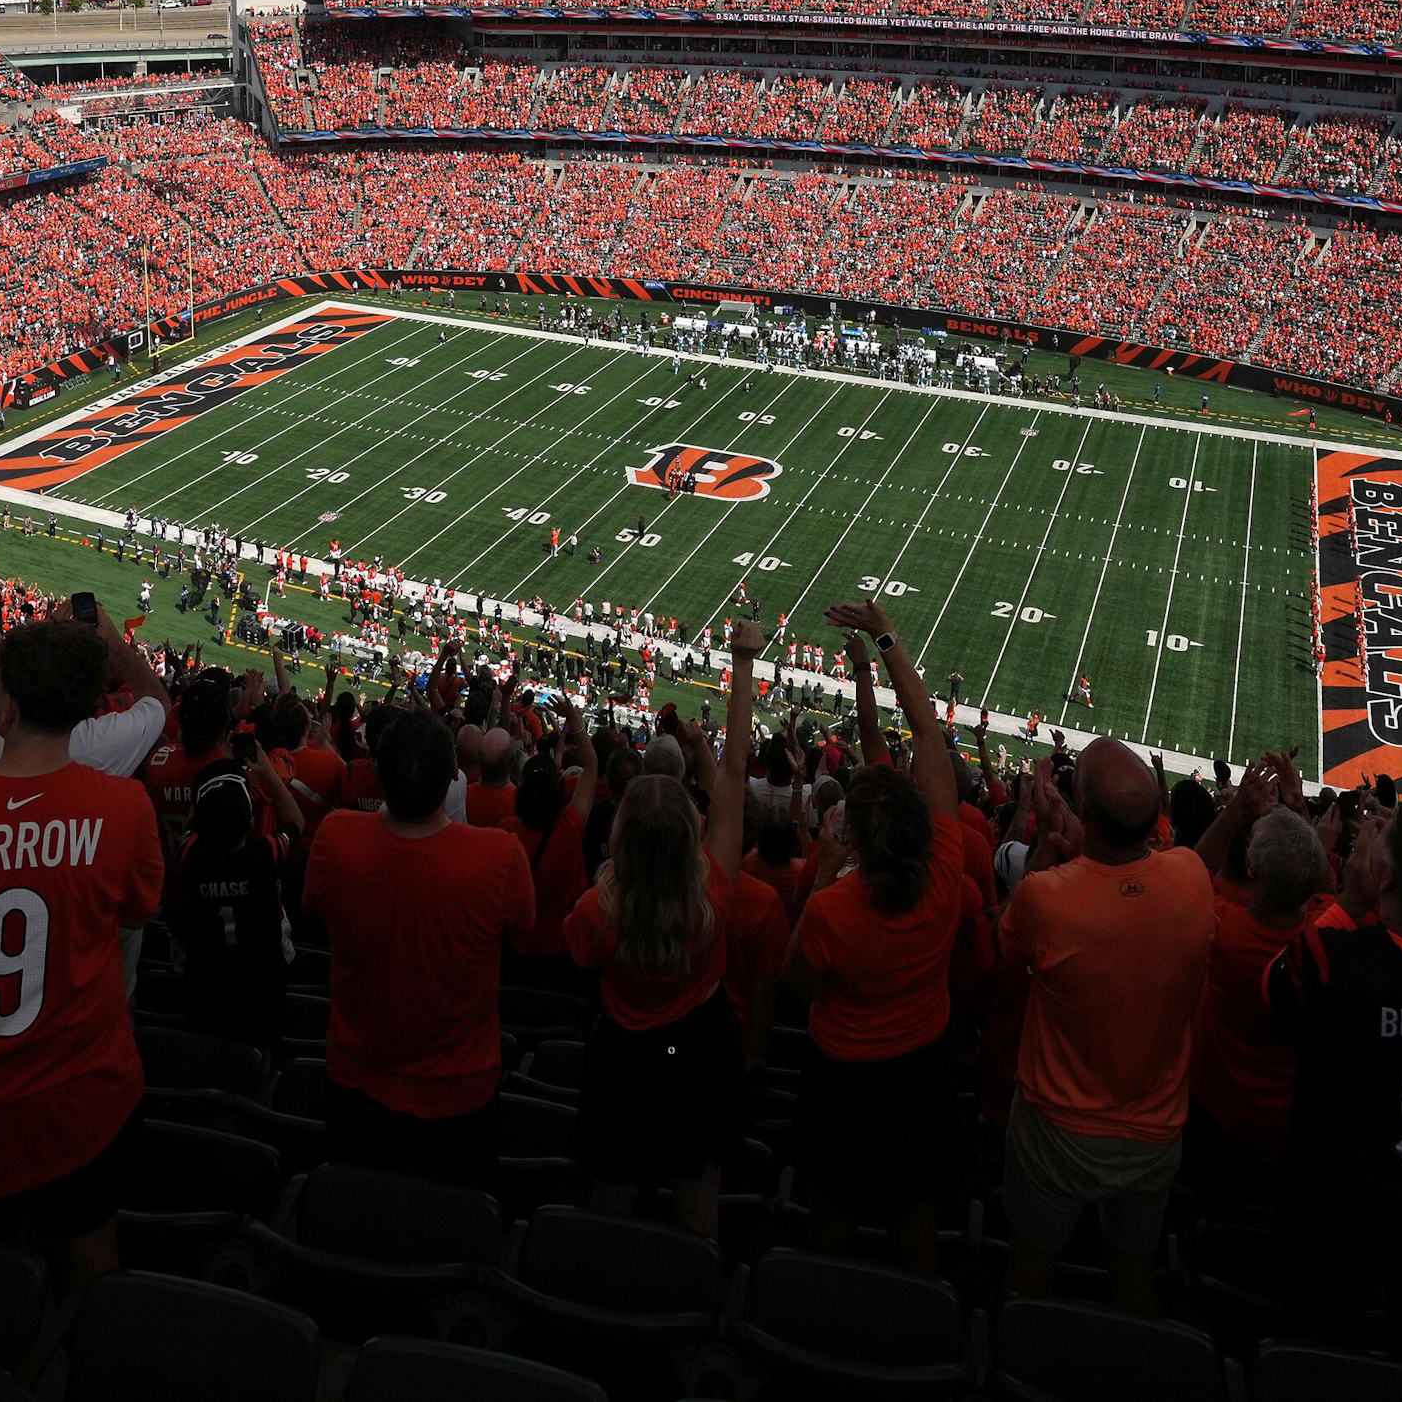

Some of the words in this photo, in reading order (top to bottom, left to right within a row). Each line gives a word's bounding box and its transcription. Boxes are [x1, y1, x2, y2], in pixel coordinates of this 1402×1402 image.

[767, 14, 786, 22] THAT
[788, 15, 855, 24] STAR-SPANGLED
[856, 16, 888, 26] BANNER
[890, 18, 905, 27] YET
[908, 19, 932, 28] WAVE
[955, 21, 971, 29] THE
[973, 22, 995, 30] LAND
[997, 23, 1008, 31] OF
[1010, 24, 1026, 32] THE
[1028, 24, 1049, 33] FREE
[1051, 25, 1069, 34] AND
[1071, 26, 1088, 36] THE
[1090, 28, 1114, 37] HOME
[1116, 29, 1127, 38] OF
[1130, 30, 1147, 39] THE
[1149, 31, 1180, 41] BRAVE
[401, 274, 439, 285] WHO
[452, 276, 487, 287] DEY
[194, 304, 222, 323] THE
[222, 286, 278, 312] JUNGLE
[672, 288, 771, 306] CINCINNATI
[946, 318, 1039, 342] BENGALS
[83, 404, 104, 413] IT
[106, 378, 162, 401] TAKES
[164, 364, 195, 377] ALL
[194, 354, 214, 363] OF
[215, 345, 239, 353] US
[39, 323, 345, 462] BENGALS
[1273, 377, 1322, 397] WHO
[1341, 392, 1387, 412] DEY
[222, 450, 259, 465] 10
[306, 468, 351, 483] 20
[403, 487, 448, 504] 30
[506, 507, 551, 525] 40
[615, 528, 663, 547] 50
[732, 551, 781, 570] 40
[858, 575, 908, 596] 30
[990, 601, 1044, 622] 20
[1145, 629, 1189, 651] 10
[163, 785, 194, 802] WAR
[199, 880, 249, 898] CHASE
[217, 904, 238, 947] 1
